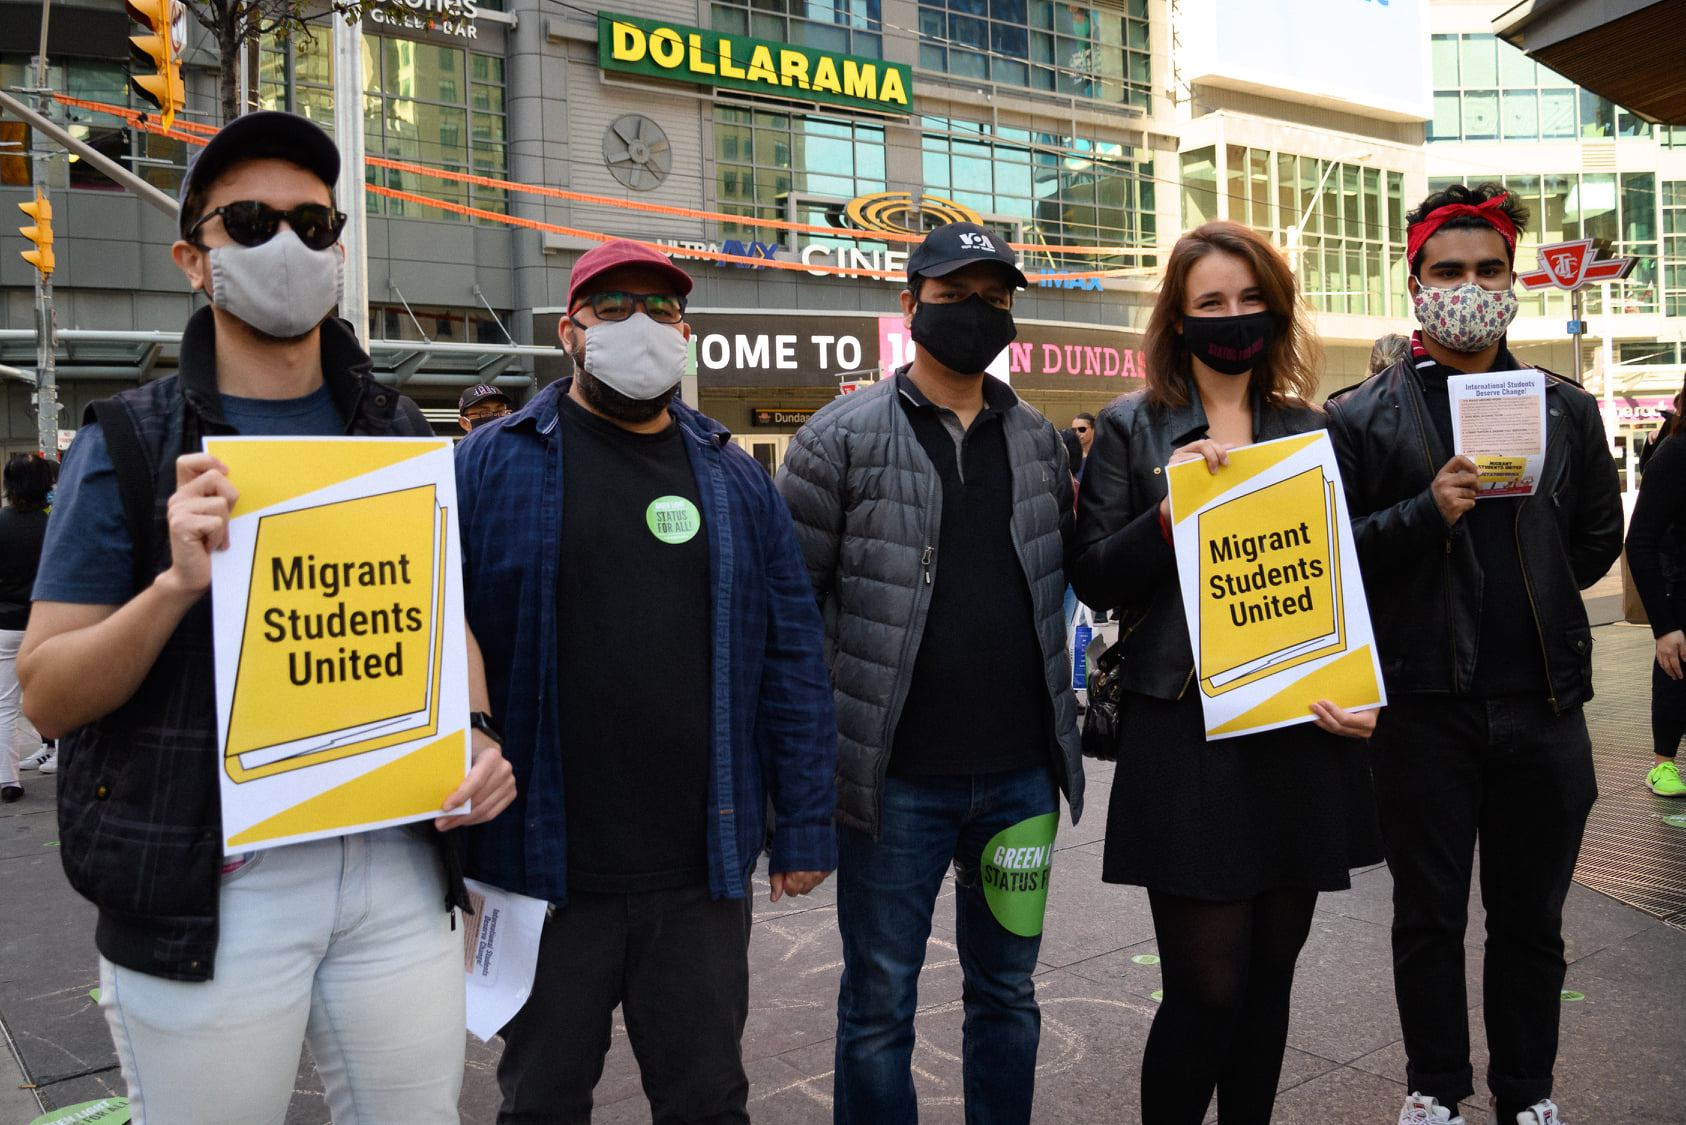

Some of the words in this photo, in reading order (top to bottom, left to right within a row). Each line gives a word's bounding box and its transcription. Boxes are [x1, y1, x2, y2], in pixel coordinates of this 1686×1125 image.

[371, 8, 426, 30] GRLL
[443, 20, 478, 39] BAR
[612, 21, 908, 105] DOLLARAMA
[657, 239, 719, 262] ULTRA
[714, 239, 780, 270] AVX
[801, 243, 909, 283] CINE
[1041, 268, 1104, 292] IMAX
[695, 333, 798, 370] OME
[811, 335, 862, 370] TO
[1042, 343, 1146, 378] DUNDAS
[1465, 381, 1506, 391] International
[1507, 380, 1535, 389] Students
[1476, 389, 1500, 397] Deserve
[1501, 388, 1527, 396] Change!
[775, 412, 810, 423] Dundas
[656, 510, 688, 522] STATUS
[657, 522, 673, 534] FOR
[675, 520, 693, 533] ALL!
[1209, 521, 1311, 564] Migrant
[271, 554, 411, 598] Migrant
[1209, 557, 1324, 600] Students
[1229, 585, 1314, 627] United
[263, 602, 423, 643] Students
[288, 641, 403, 686] United
[993, 845, 1046, 870] GREEN
[985, 864, 1038, 892] STATUS
[1041, 868, 1049, 890] F
